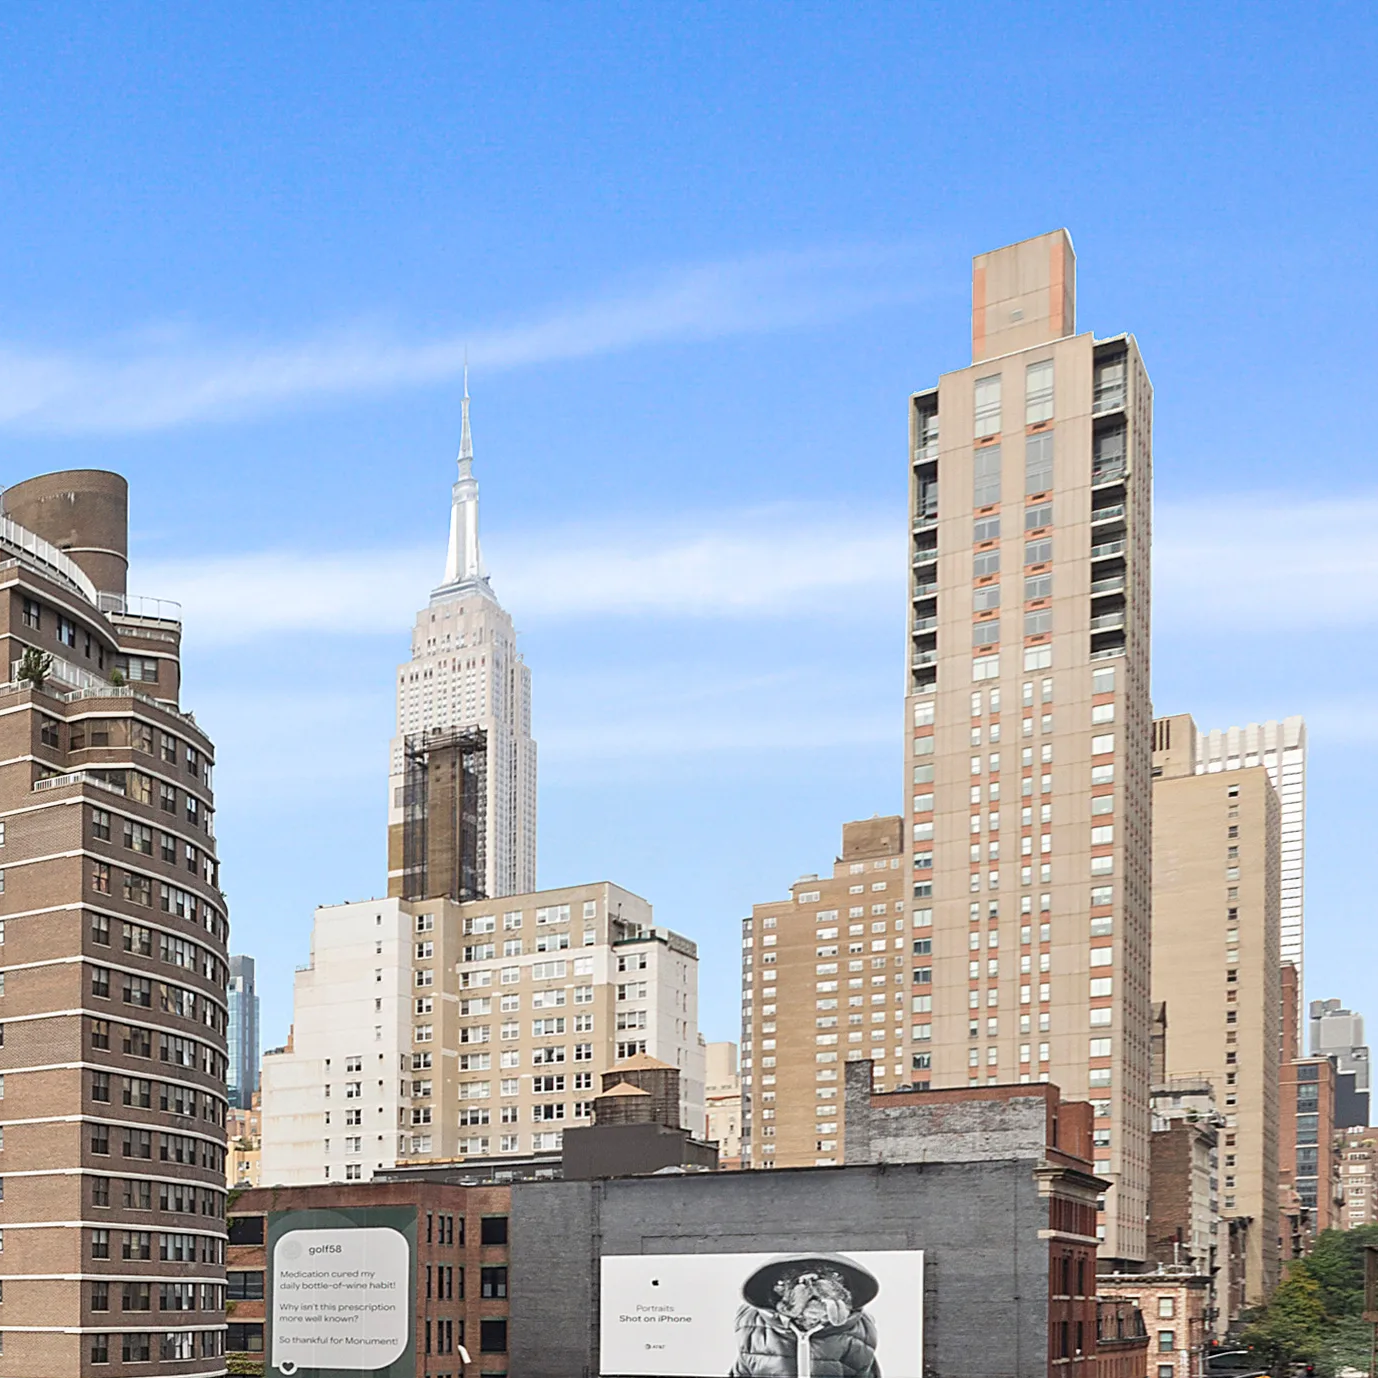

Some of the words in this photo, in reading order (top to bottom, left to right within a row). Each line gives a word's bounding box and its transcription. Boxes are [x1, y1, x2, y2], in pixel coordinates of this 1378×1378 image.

[308, 1245, 342, 1256] golf58
[280, 1270, 330, 1278] Medication
[331, 1270, 359, 1278] cured
[361, 1271, 376, 1279] my
[280, 1282, 301, 1291] daily
[302, 1281, 368, 1290] bottle-of-wine
[369, 1281, 396, 1290] habit!
[279, 1303, 300, 1311] Why
[300, 1303, 318, 1311] isn't
[320, 1303, 336, 1311] this
[338, 1302, 396, 1312] prescription
[635, 1304, 675, 1312] Portraits
[304, 1314, 323, 1322] well
[324, 1314, 359, 1323] known?
[619, 1314, 642, 1323] Shot
[658, 1314, 693, 1323] iPhone
[279, 1335, 291, 1344] So
[292, 1336, 329, 1344] thankful
[330, 1336, 343, 1345] for
[345, 1336, 399, 1346] Monument!
